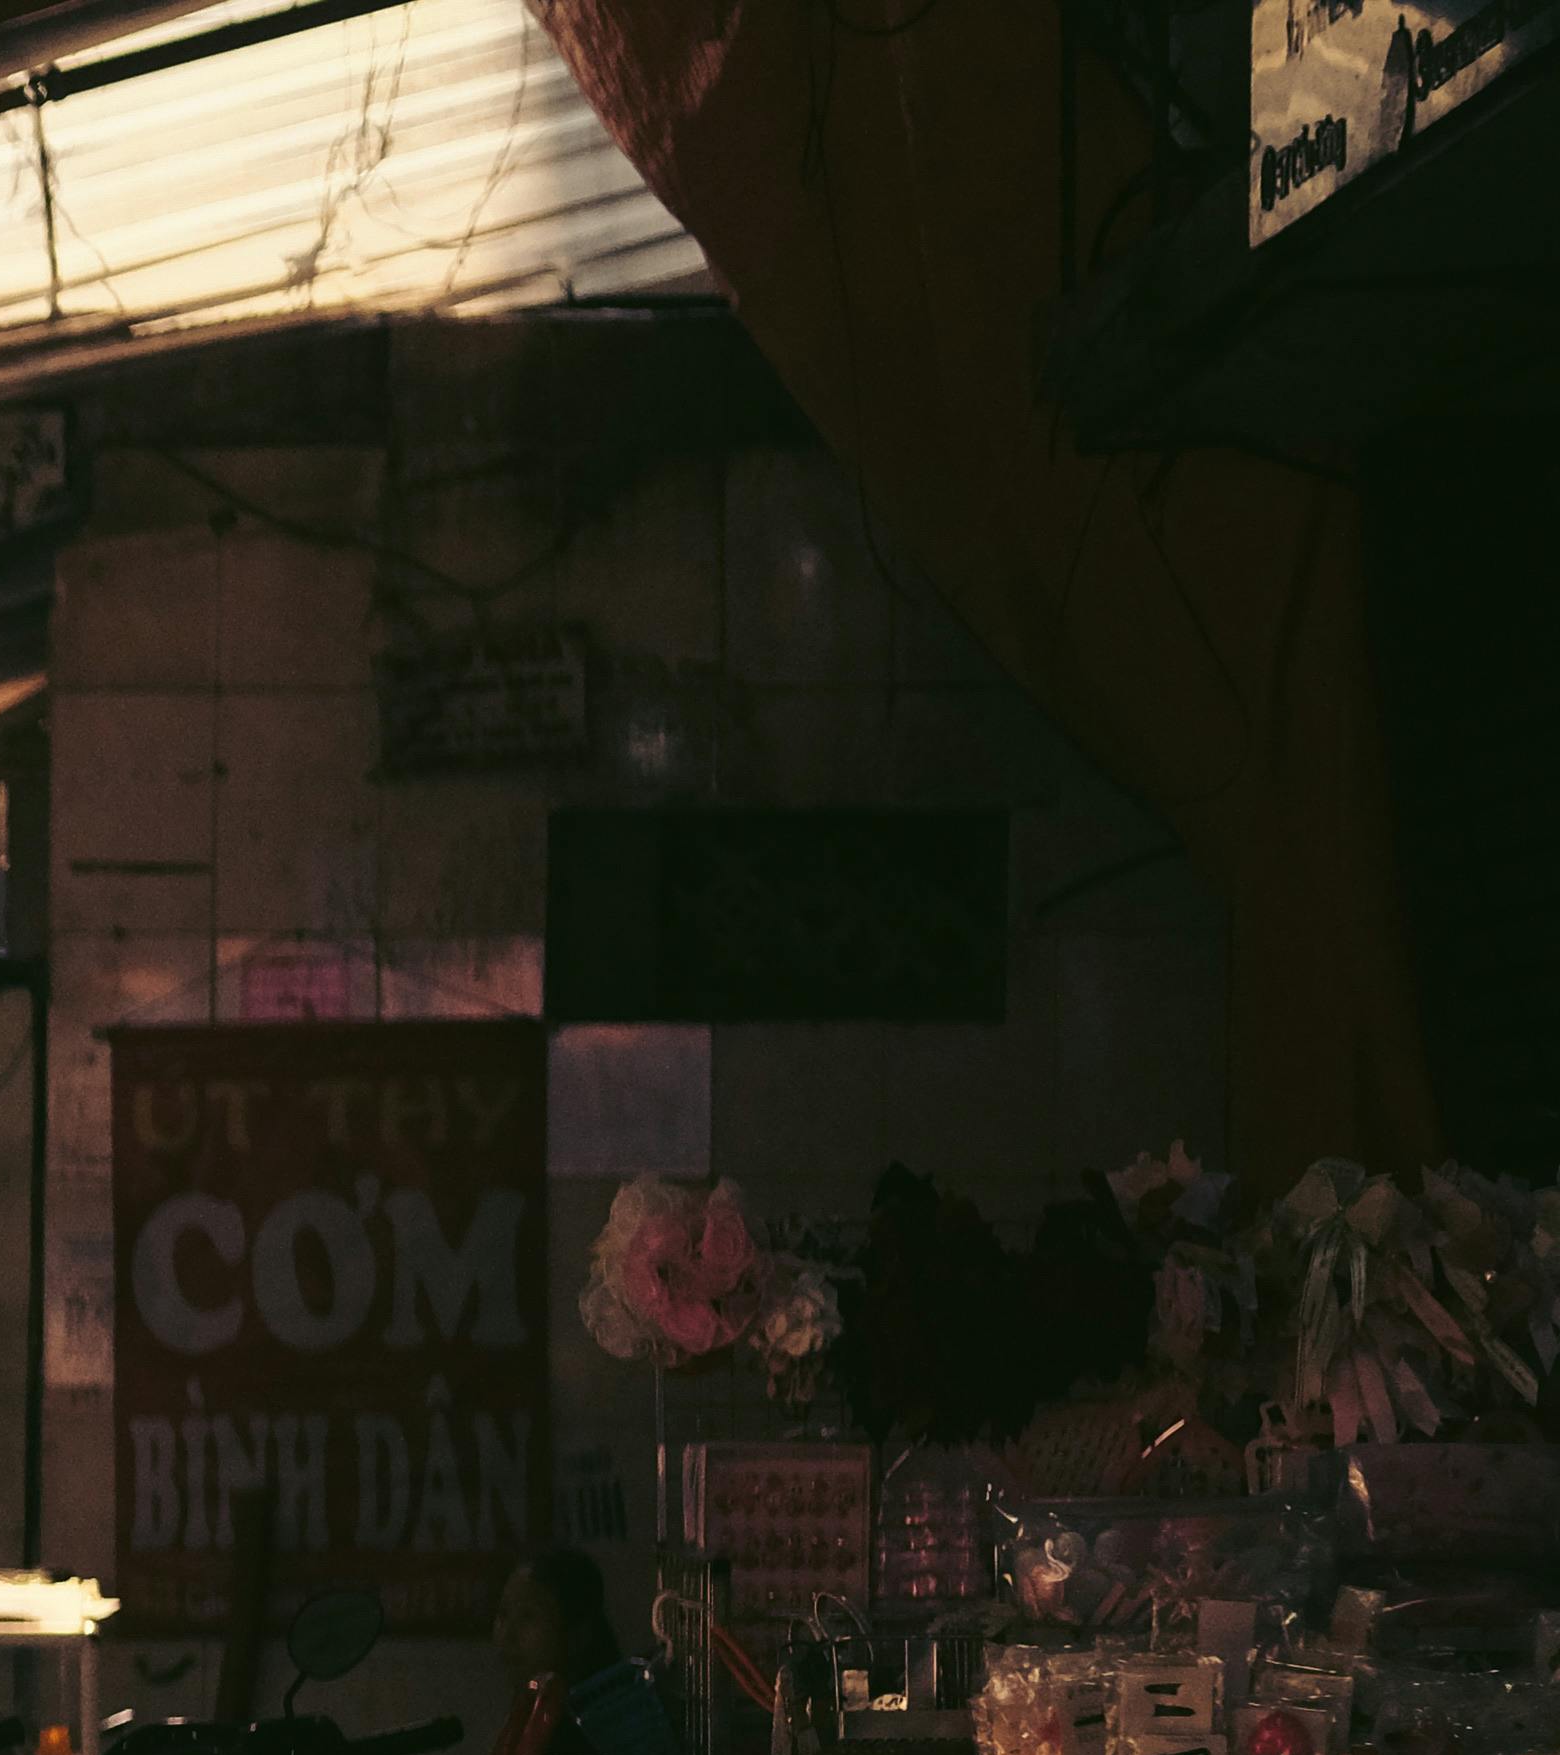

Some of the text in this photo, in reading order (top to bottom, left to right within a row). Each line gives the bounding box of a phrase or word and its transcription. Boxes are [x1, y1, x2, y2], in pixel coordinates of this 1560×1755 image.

[131, 1174, 529, 1356] CƠM
[129, 1373, 533, 1555] BÌNH DÂN
